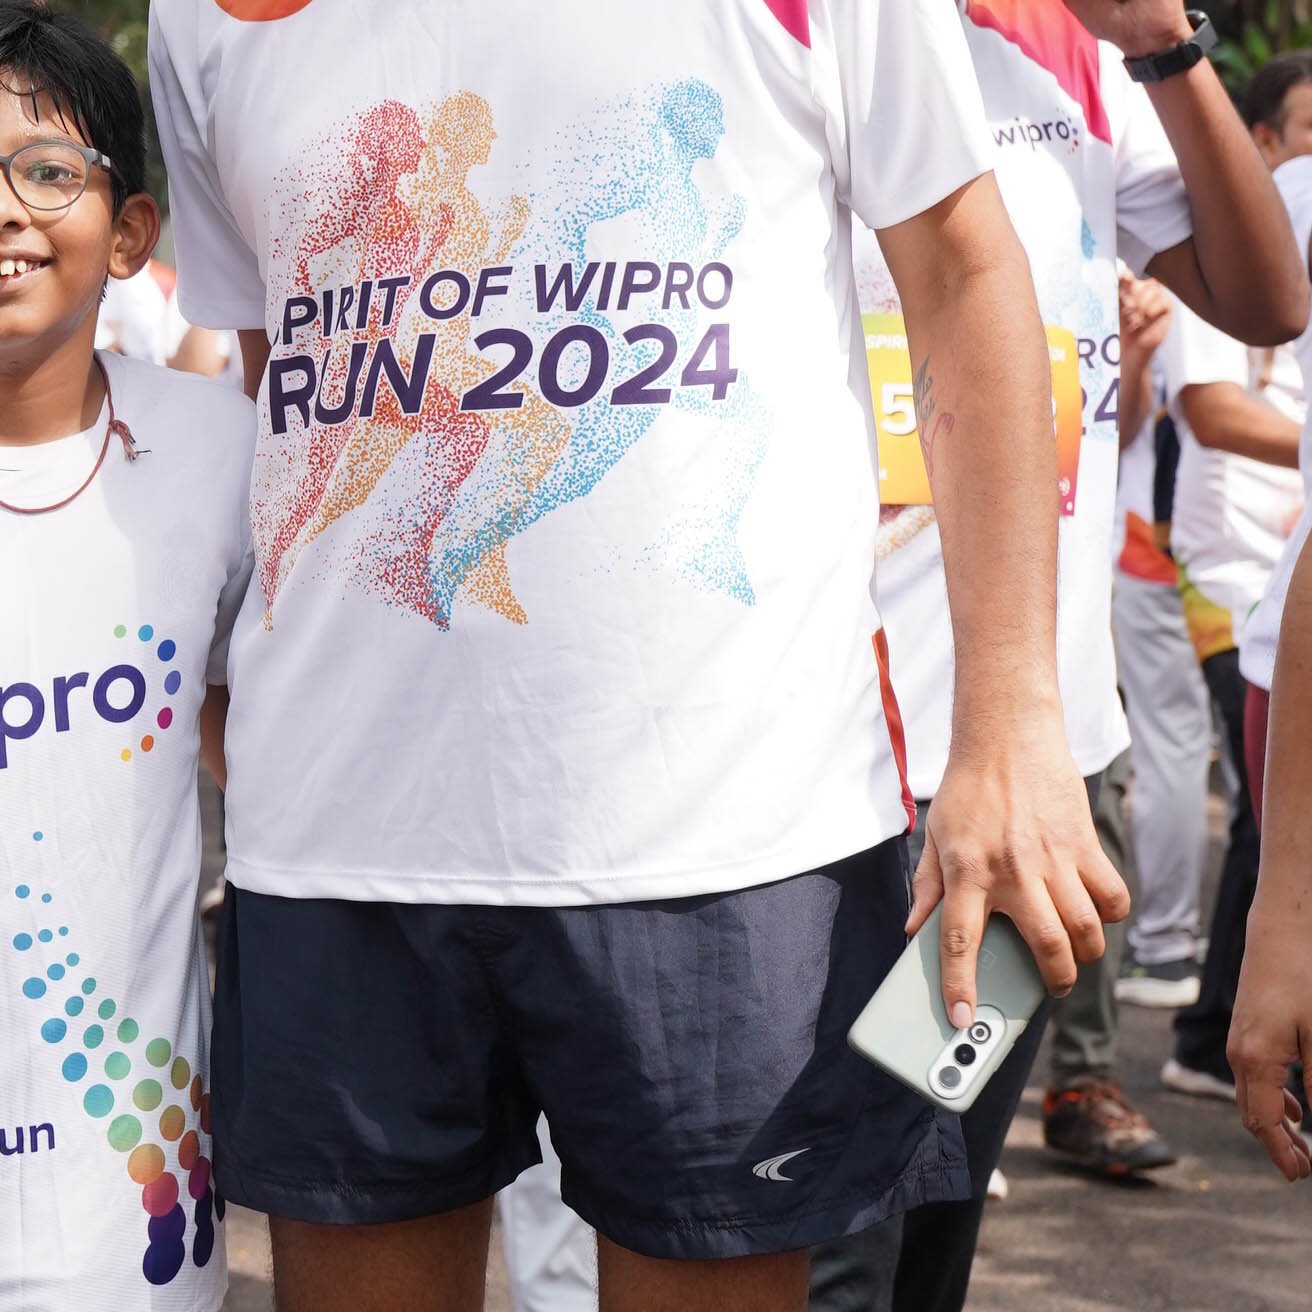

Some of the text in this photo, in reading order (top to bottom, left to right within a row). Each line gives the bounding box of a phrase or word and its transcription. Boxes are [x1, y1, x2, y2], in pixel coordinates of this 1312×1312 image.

[992, 117, 1069, 151] wipro
[273, 261, 733, 347] PIRIT OF WIPRO
[269, 323, 738, 435] RUN 2024
